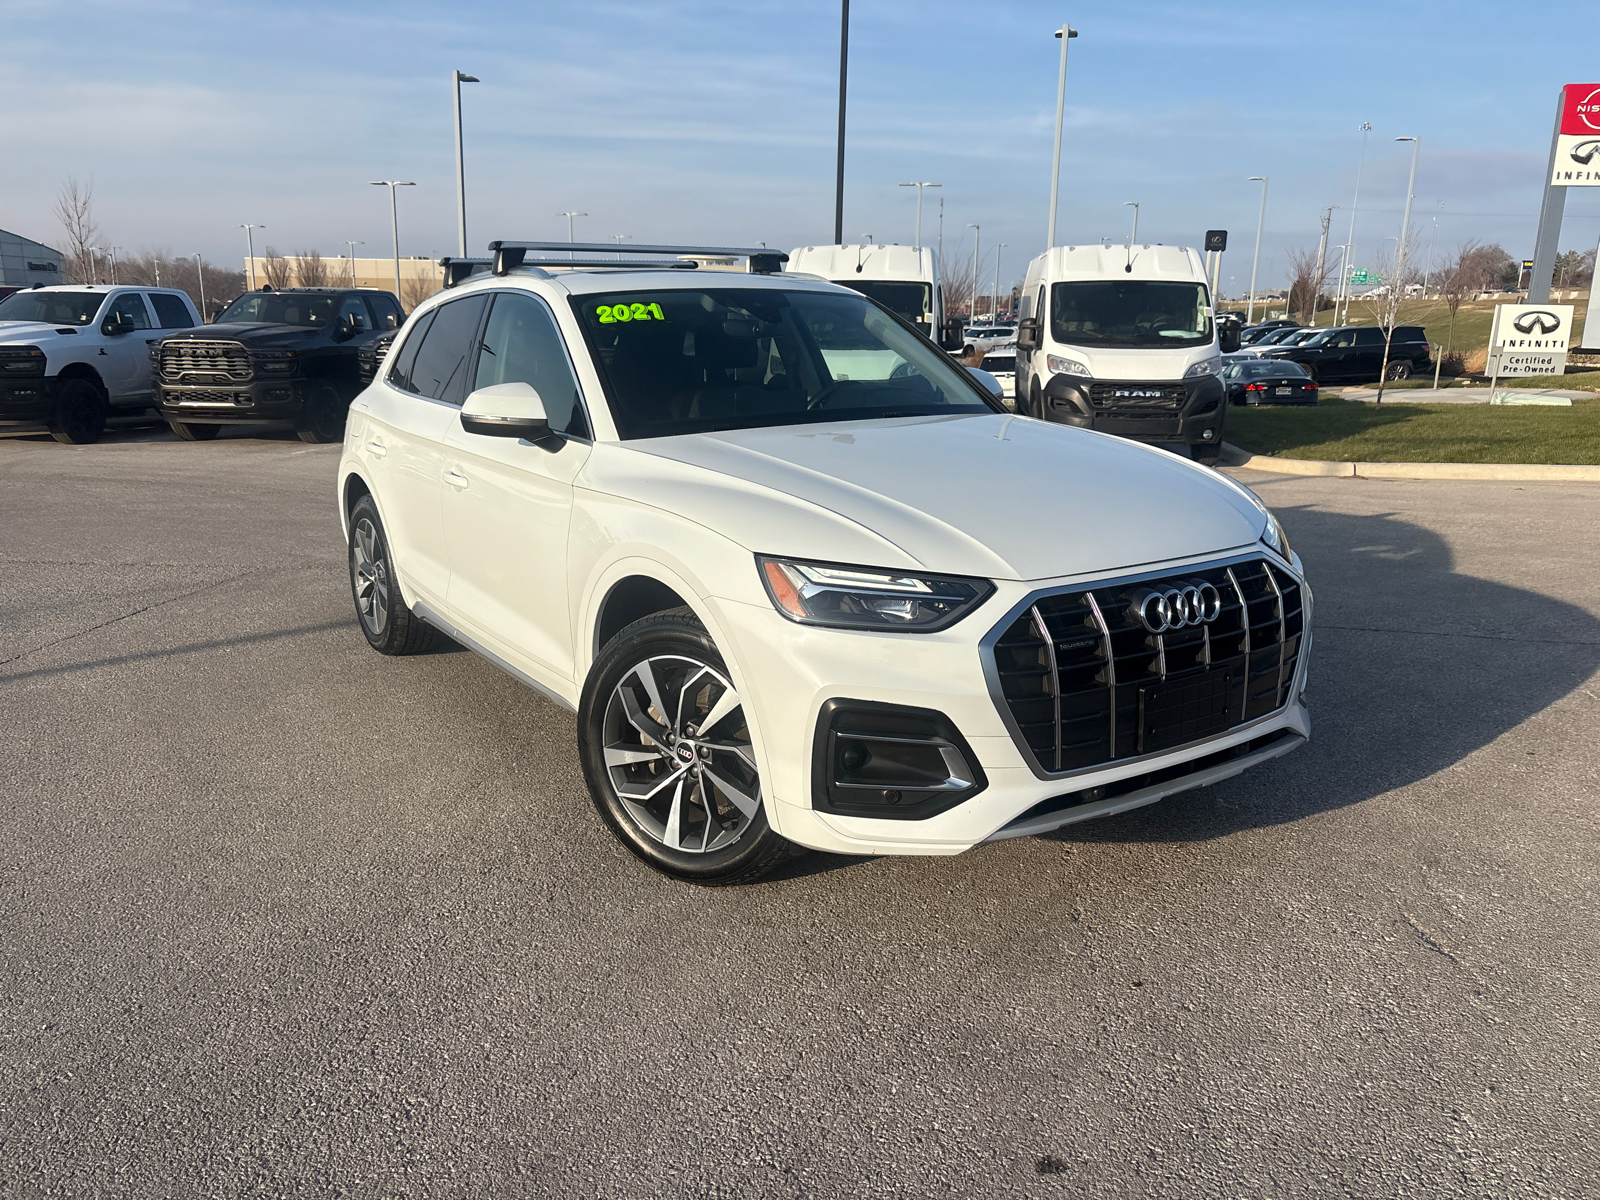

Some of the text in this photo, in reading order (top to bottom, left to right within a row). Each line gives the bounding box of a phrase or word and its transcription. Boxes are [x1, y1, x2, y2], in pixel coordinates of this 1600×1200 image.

[596, 302, 665, 324] 2021
[1502, 339, 1564, 348] INFINITI
[180, 347, 223, 357] RAM
[1509, 356, 1553, 365] Certified
[1502, 365, 1556, 373] Pre-Owned
